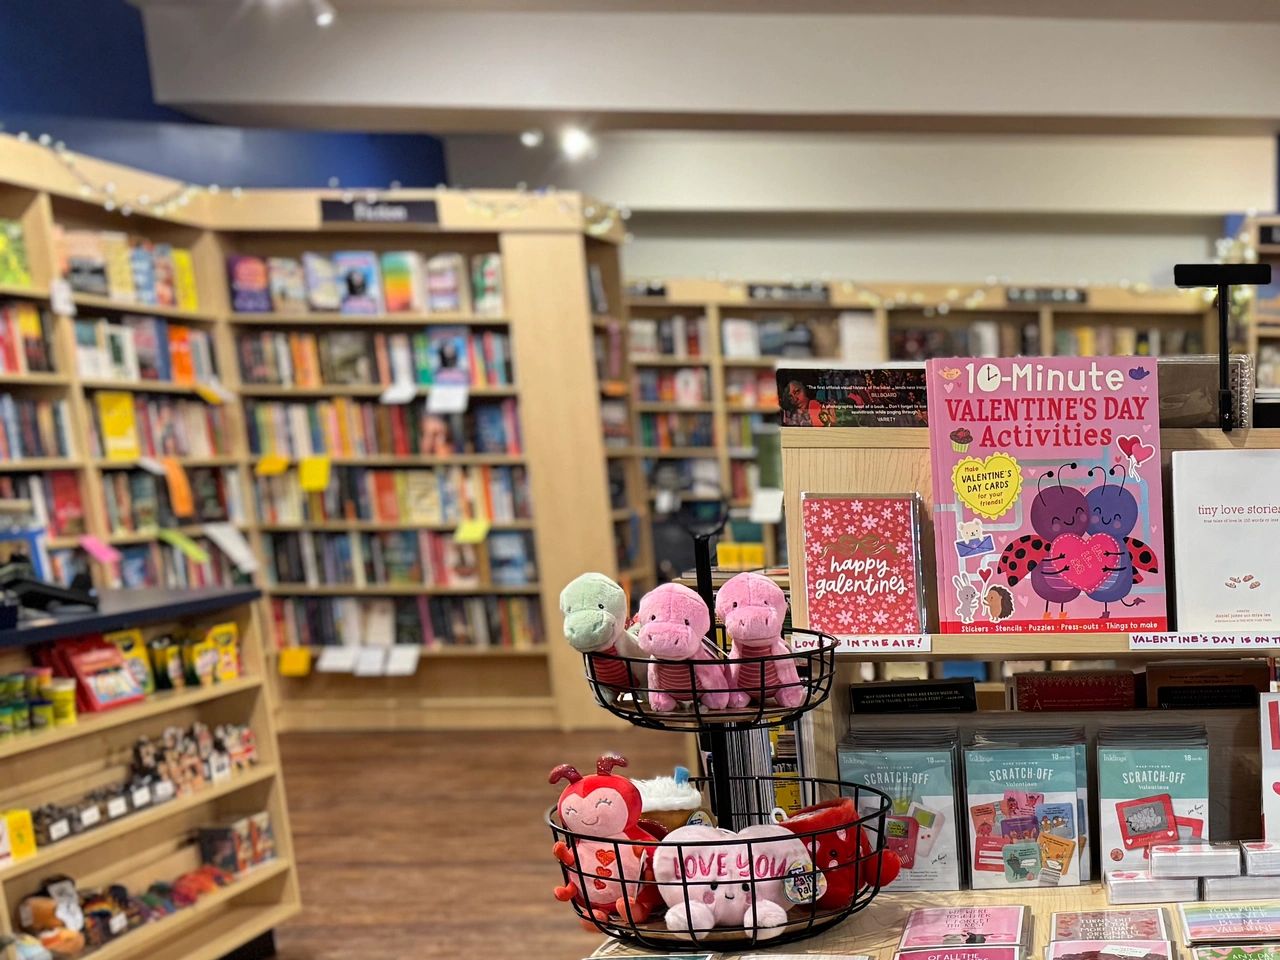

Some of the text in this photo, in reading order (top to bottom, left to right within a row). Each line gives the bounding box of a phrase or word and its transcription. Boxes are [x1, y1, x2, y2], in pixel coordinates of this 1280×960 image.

[966, 362, 1125, 394] 10-Minute
[945, 396, 1149, 422] VALENTINE'S DAY
[979, 423, 1112, 448] Activities
[962, 469, 1012, 484] VALENTINE'S
[967, 481, 1009, 493] DAY CARDS
[980, 499, 1004, 507] friends!
[989, 492, 1003, 500] your
[1198, 504, 1218, 517] tiny
[1221, 504, 1244, 515] love
[831, 556, 890, 579] happy
[961, 625, 989, 633] Stickers
[995, 624, 1022, 633] Stencils
[1028, 624, 1055, 632] Puzzles
[1060, 623, 1099, 631] Press-outs
[1105, 622, 1129, 631] Things
[1139, 621, 1158, 629] make
[1132, 634, 1209, 645] VALENTINE'S
[1212, 635, 1235, 645] DAY
[1240, 635, 1251, 644] IS
[1255, 635, 1270, 644] ON
[864, 771, 929, 785] SCRATCH-OFF
[989, 768, 1054, 782] SCRATCH-OFF
[1122, 770, 1187, 784] SCRATCH-OFF
[673, 852, 788, 880] LOVE YOU
